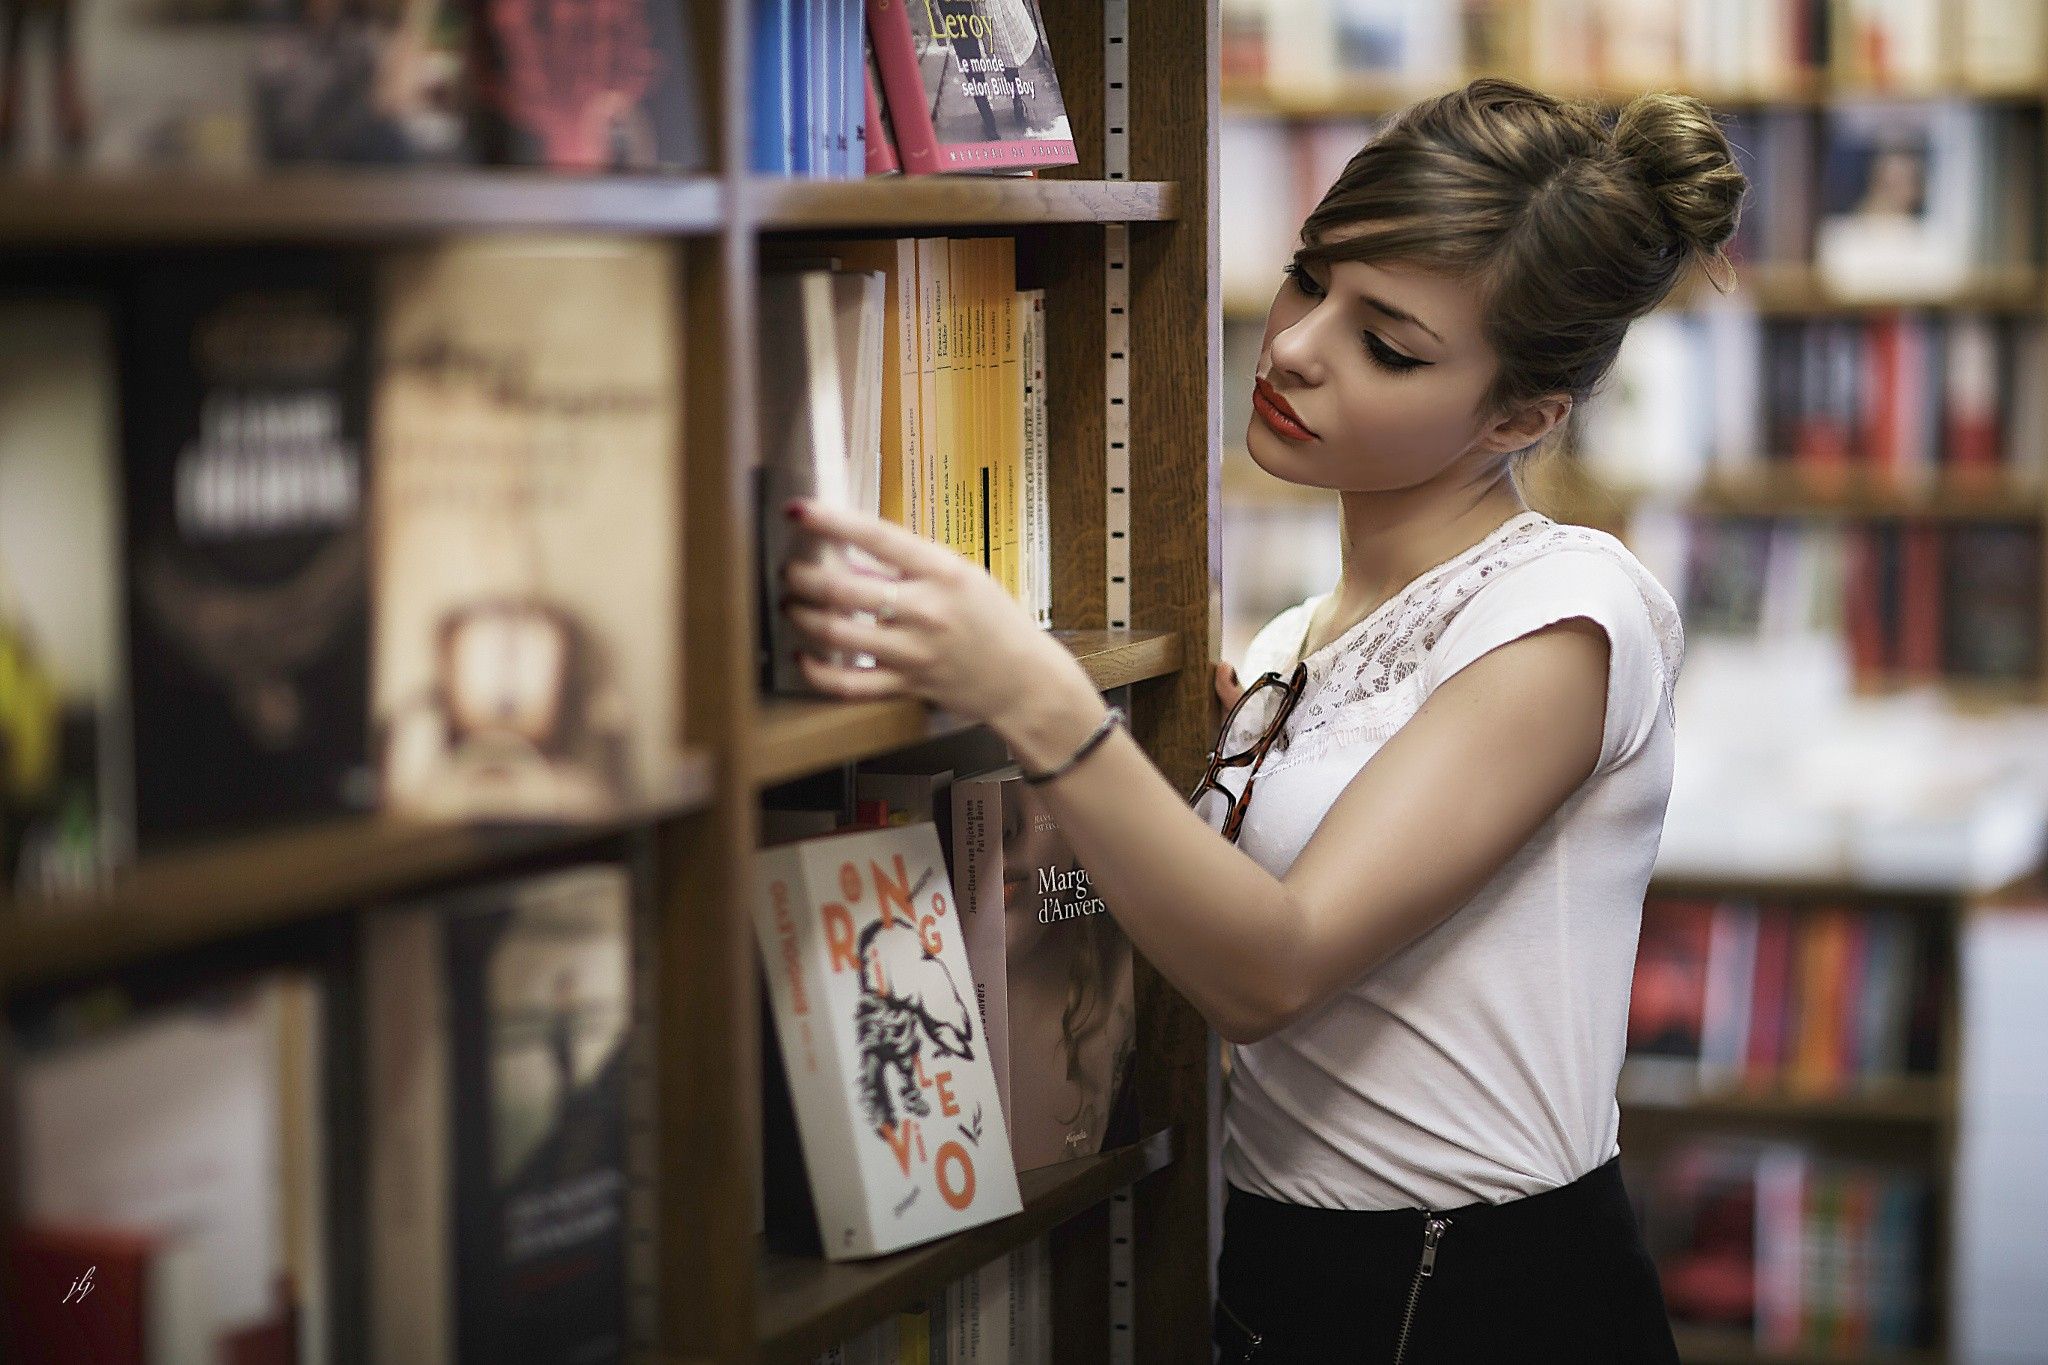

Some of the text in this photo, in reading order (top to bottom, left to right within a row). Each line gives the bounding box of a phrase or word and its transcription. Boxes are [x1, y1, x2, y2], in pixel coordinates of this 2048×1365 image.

[924, 0, 993, 53] Leroy
[956, 54, 1005, 73] Le monde
[962, 77, 1035, 99] selon Billy Boy
[1037, 865, 1093, 900] Margo
[1038, 896, 1106, 924] d'Anvers
